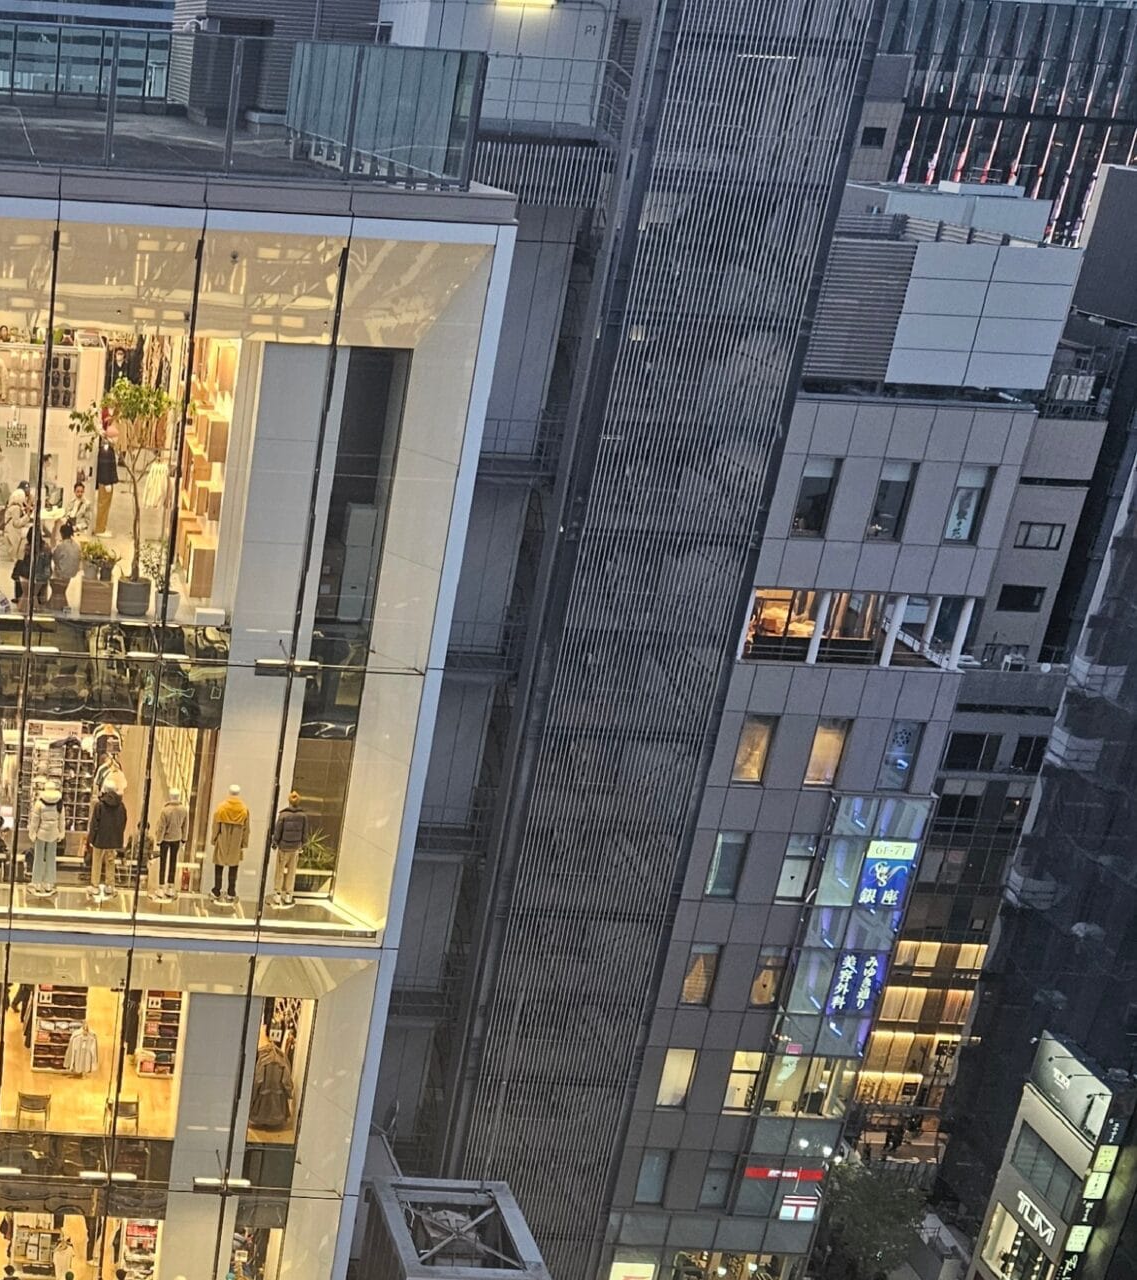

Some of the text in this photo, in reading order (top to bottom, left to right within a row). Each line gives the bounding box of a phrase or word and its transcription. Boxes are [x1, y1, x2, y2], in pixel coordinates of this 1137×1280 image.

[858, 888, 900, 906] 銀座
[831, 955, 858, 1010] 美容外科
[856, 956, 879, 1010] みゆき通り
[1017, 1189, 1057, 1246] TUMI
